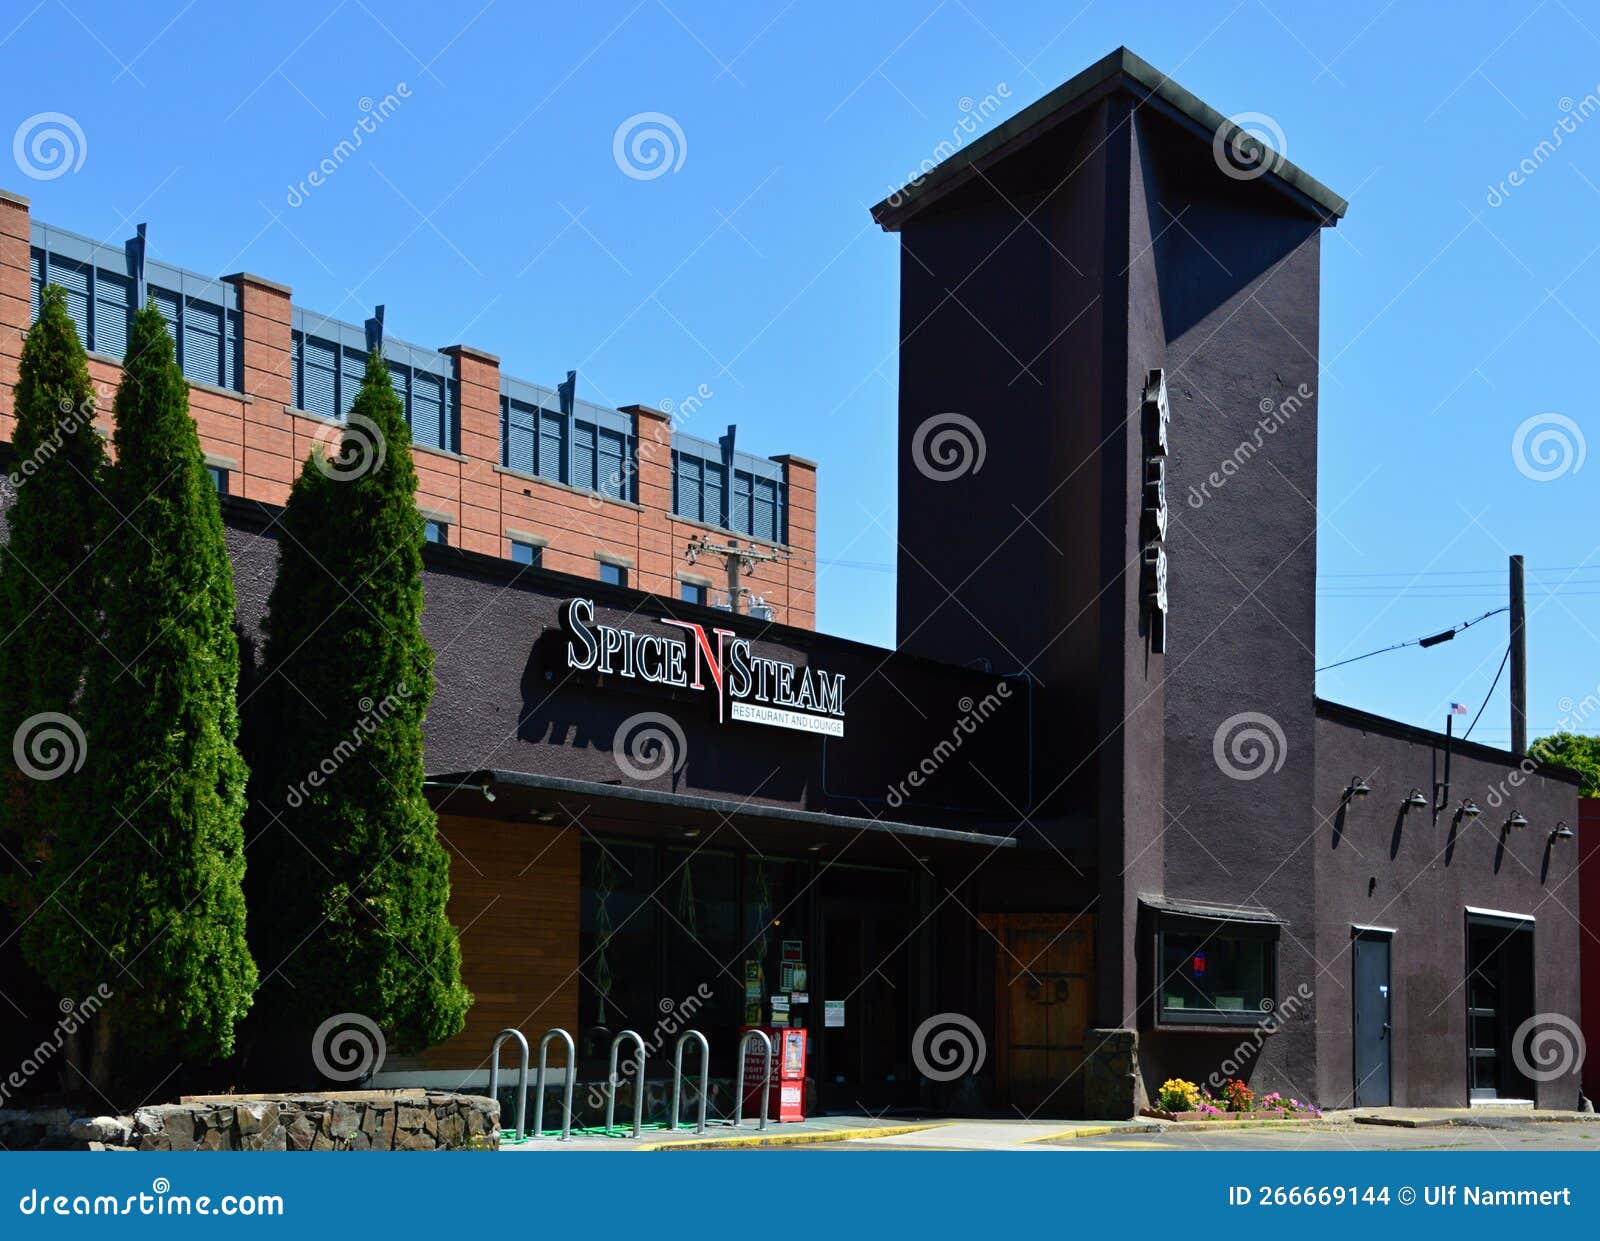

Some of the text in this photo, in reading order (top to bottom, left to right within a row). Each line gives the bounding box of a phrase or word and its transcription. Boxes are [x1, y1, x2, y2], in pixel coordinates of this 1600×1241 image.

[567, 598, 845, 723] SPICE N STEAM
[733, 704, 842, 733] RESTAURANT AND LOUNGE
